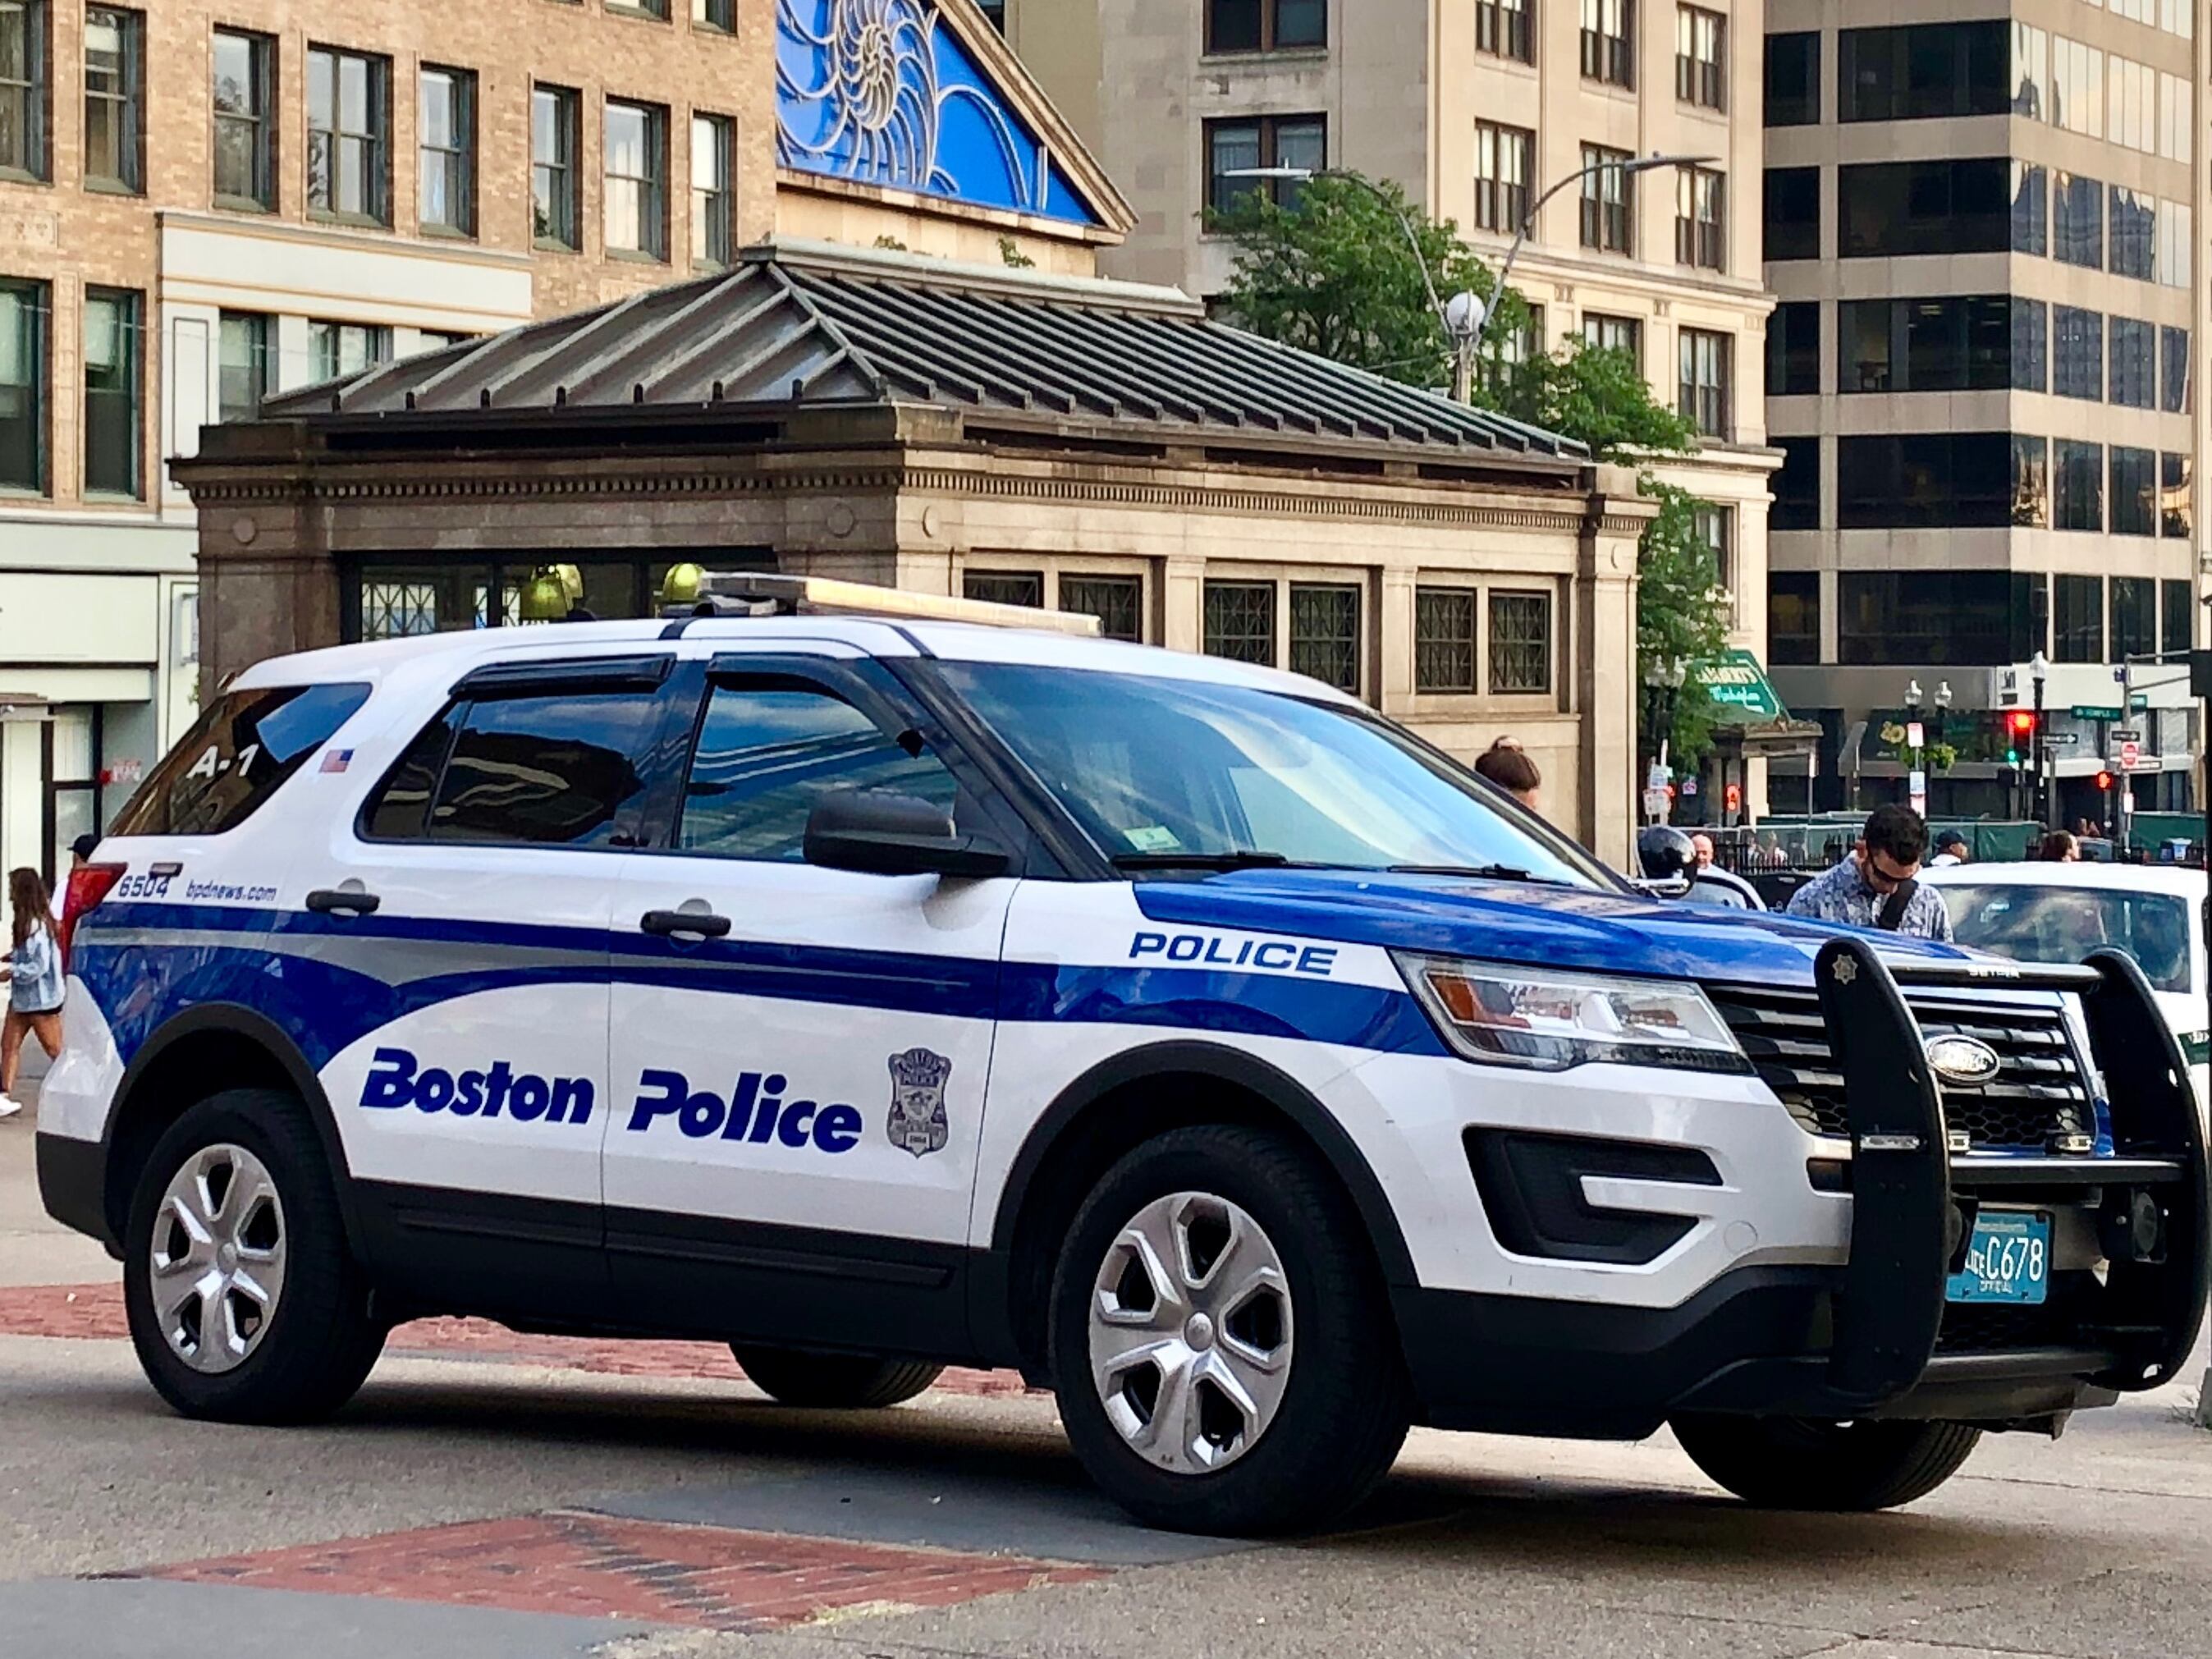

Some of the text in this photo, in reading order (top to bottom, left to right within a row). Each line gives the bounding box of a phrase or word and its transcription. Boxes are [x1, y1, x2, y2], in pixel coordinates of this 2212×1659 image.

[186, 744, 259, 778] A-1
[118, 875, 172, 899] 6504
[186, 878, 277, 902] bpdnews.com
[1129, 932, 1338, 975] POLICE
[360, 1047, 863, 1153] Boston Police
[1986, 1236, 2043, 1281] C678
